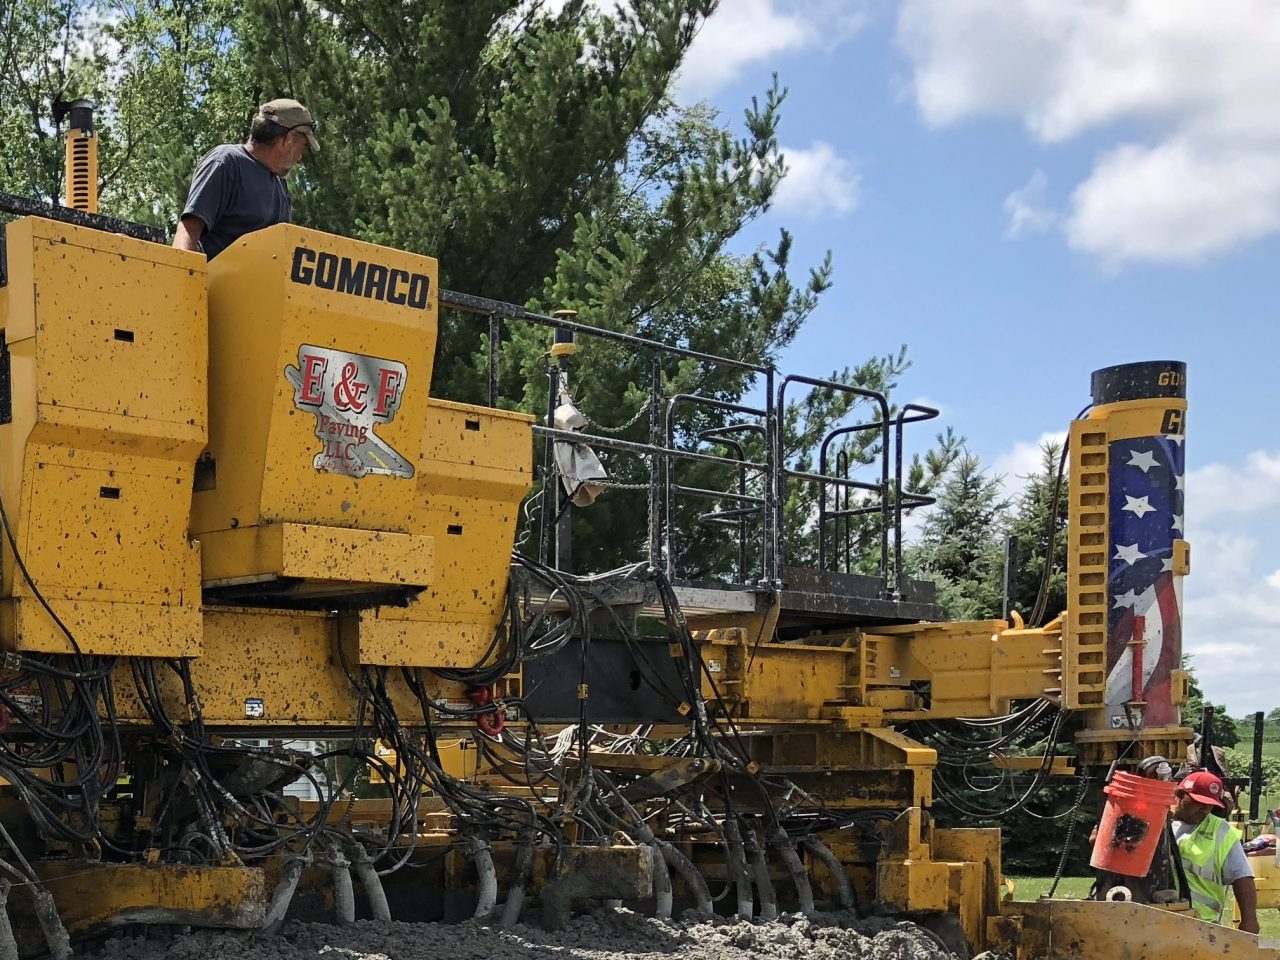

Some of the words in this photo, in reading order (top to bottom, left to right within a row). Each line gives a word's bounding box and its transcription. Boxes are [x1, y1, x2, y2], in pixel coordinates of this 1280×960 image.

[290, 246, 431, 310] GOMACO
[299, 354, 327, 405] E
[333, 361, 368, 413] &
[372, 367, 401, 417] F
[319, 415, 368, 444] Paving
[324, 440, 356, 460] LLC
